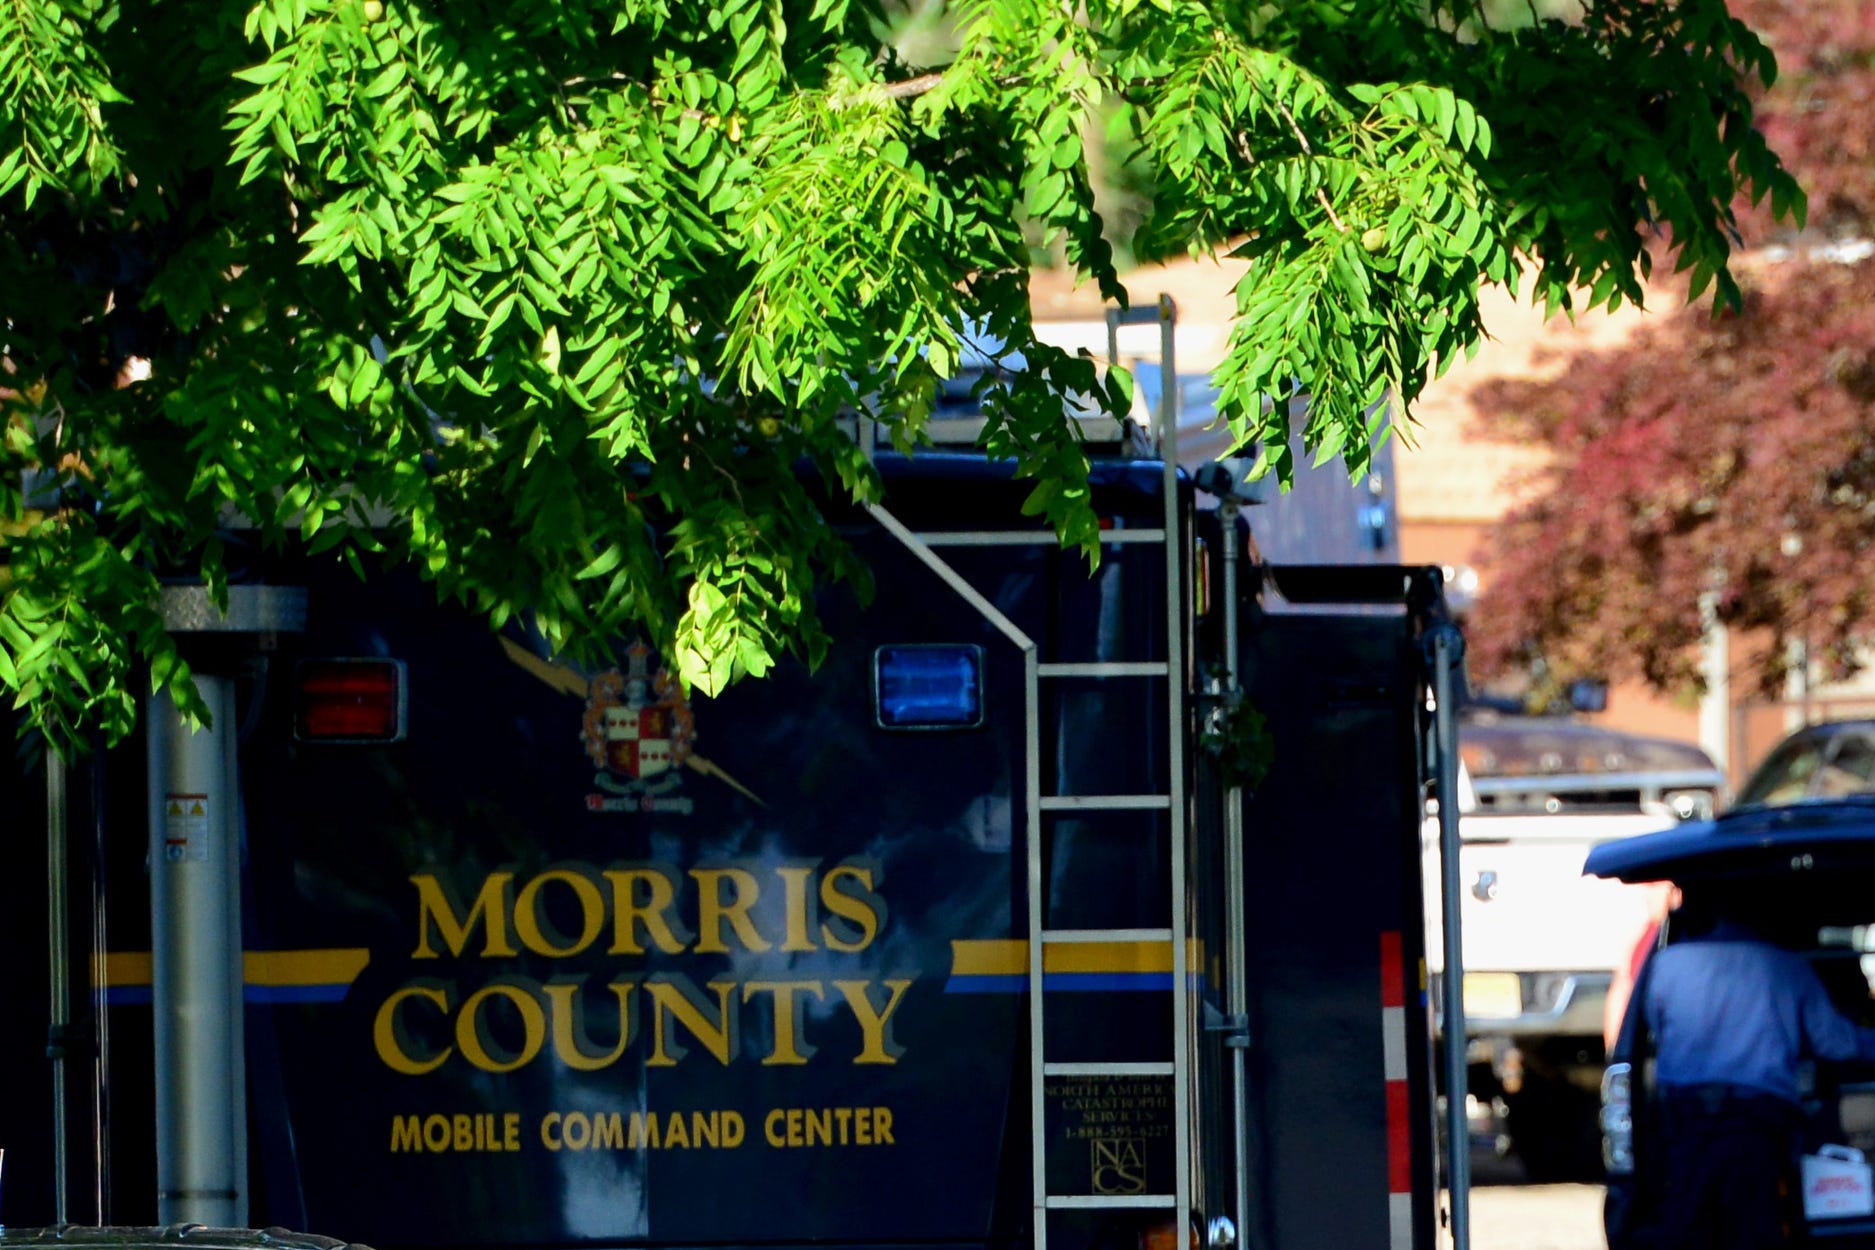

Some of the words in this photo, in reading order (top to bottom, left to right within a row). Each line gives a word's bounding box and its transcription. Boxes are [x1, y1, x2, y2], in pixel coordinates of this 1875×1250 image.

[409, 862, 883, 959] MORRIS
[373, 975, 917, 1075] COUNTY
[390, 1114, 520, 1152] MOBILE
[541, 1111, 745, 1151] COMMAND
[765, 1107, 895, 1147] CENTER
